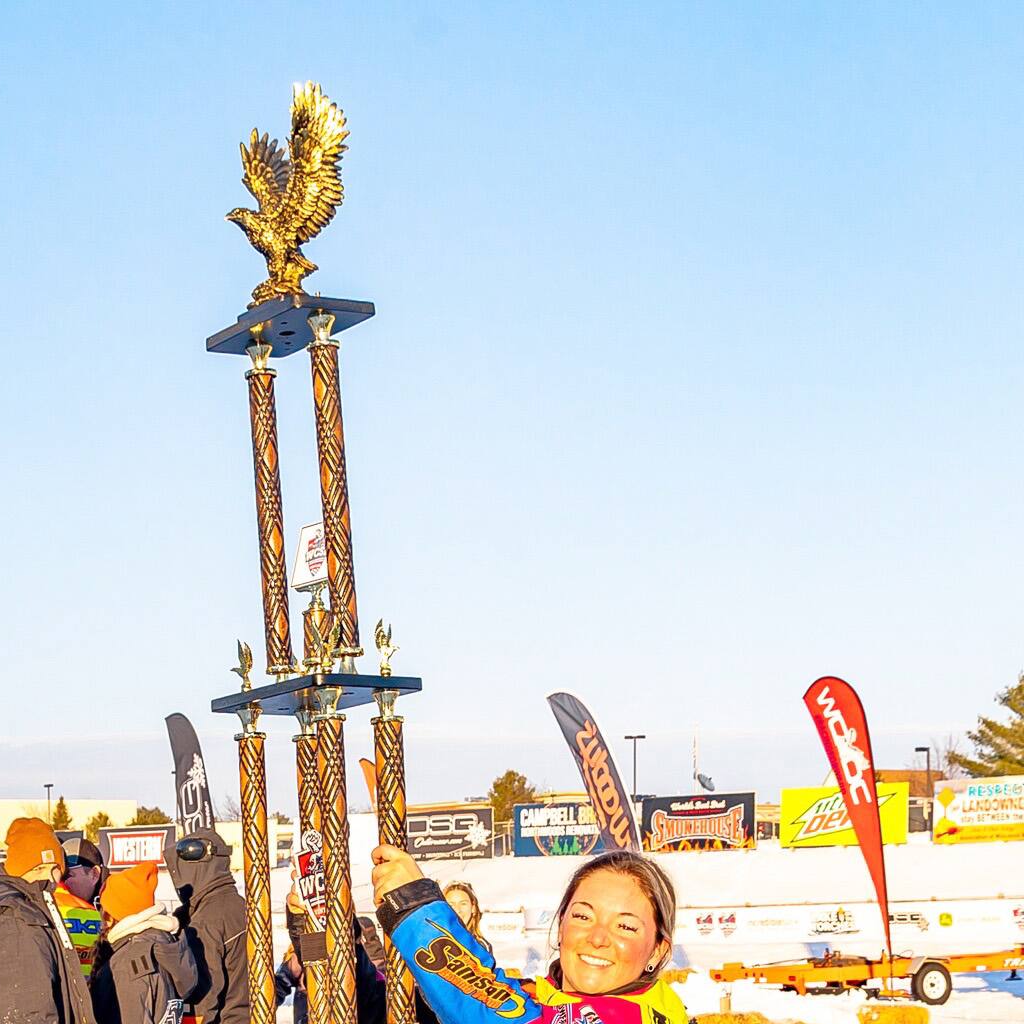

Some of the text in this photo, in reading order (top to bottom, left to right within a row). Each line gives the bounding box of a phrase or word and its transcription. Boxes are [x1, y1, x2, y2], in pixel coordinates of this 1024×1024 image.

[967, 784, 1024, 797] RESPEC
[406, 814, 478, 838] DSG
[520, 806, 576, 827] CAMPBELL
[652, 805, 744, 846] SMOKEHOUSE
[414, 936, 512, 1002] Samson
